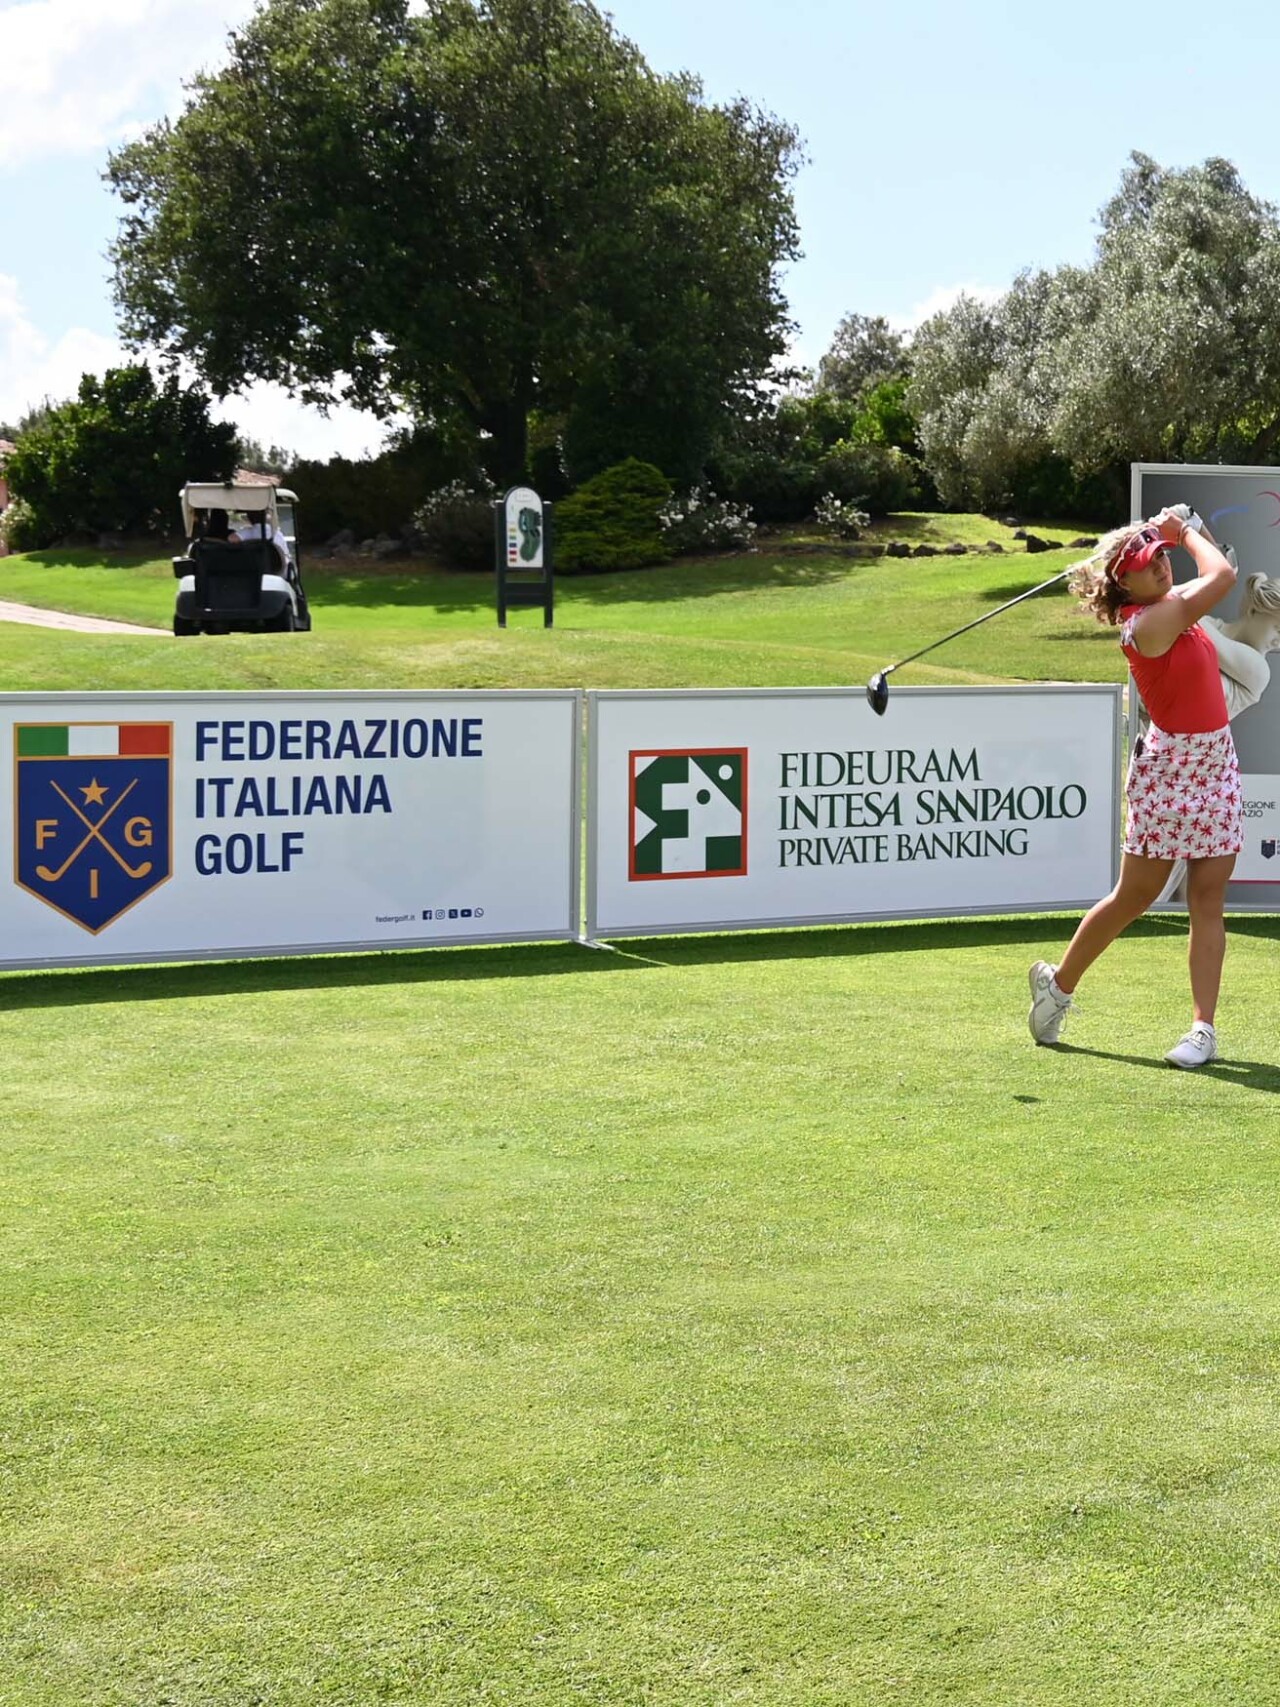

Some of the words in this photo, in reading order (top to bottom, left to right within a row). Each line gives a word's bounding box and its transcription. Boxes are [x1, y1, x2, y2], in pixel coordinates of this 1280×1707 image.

[195, 718, 484, 761] FEDERAZIONE
[777, 747, 983, 789] FIDEURAM
[195, 774, 392, 818] ITALIANA
[777, 791, 902, 831] INTESA
[916, 784, 1087, 825] SANPAOLO
[1241, 800, 1276, 810] EGIONE
[1241, 809, 1264, 818] AZIO
[194, 832, 305, 875] GOLF
[777, 834, 890, 867] PRIVATE
[896, 828, 1030, 862] BANKING
